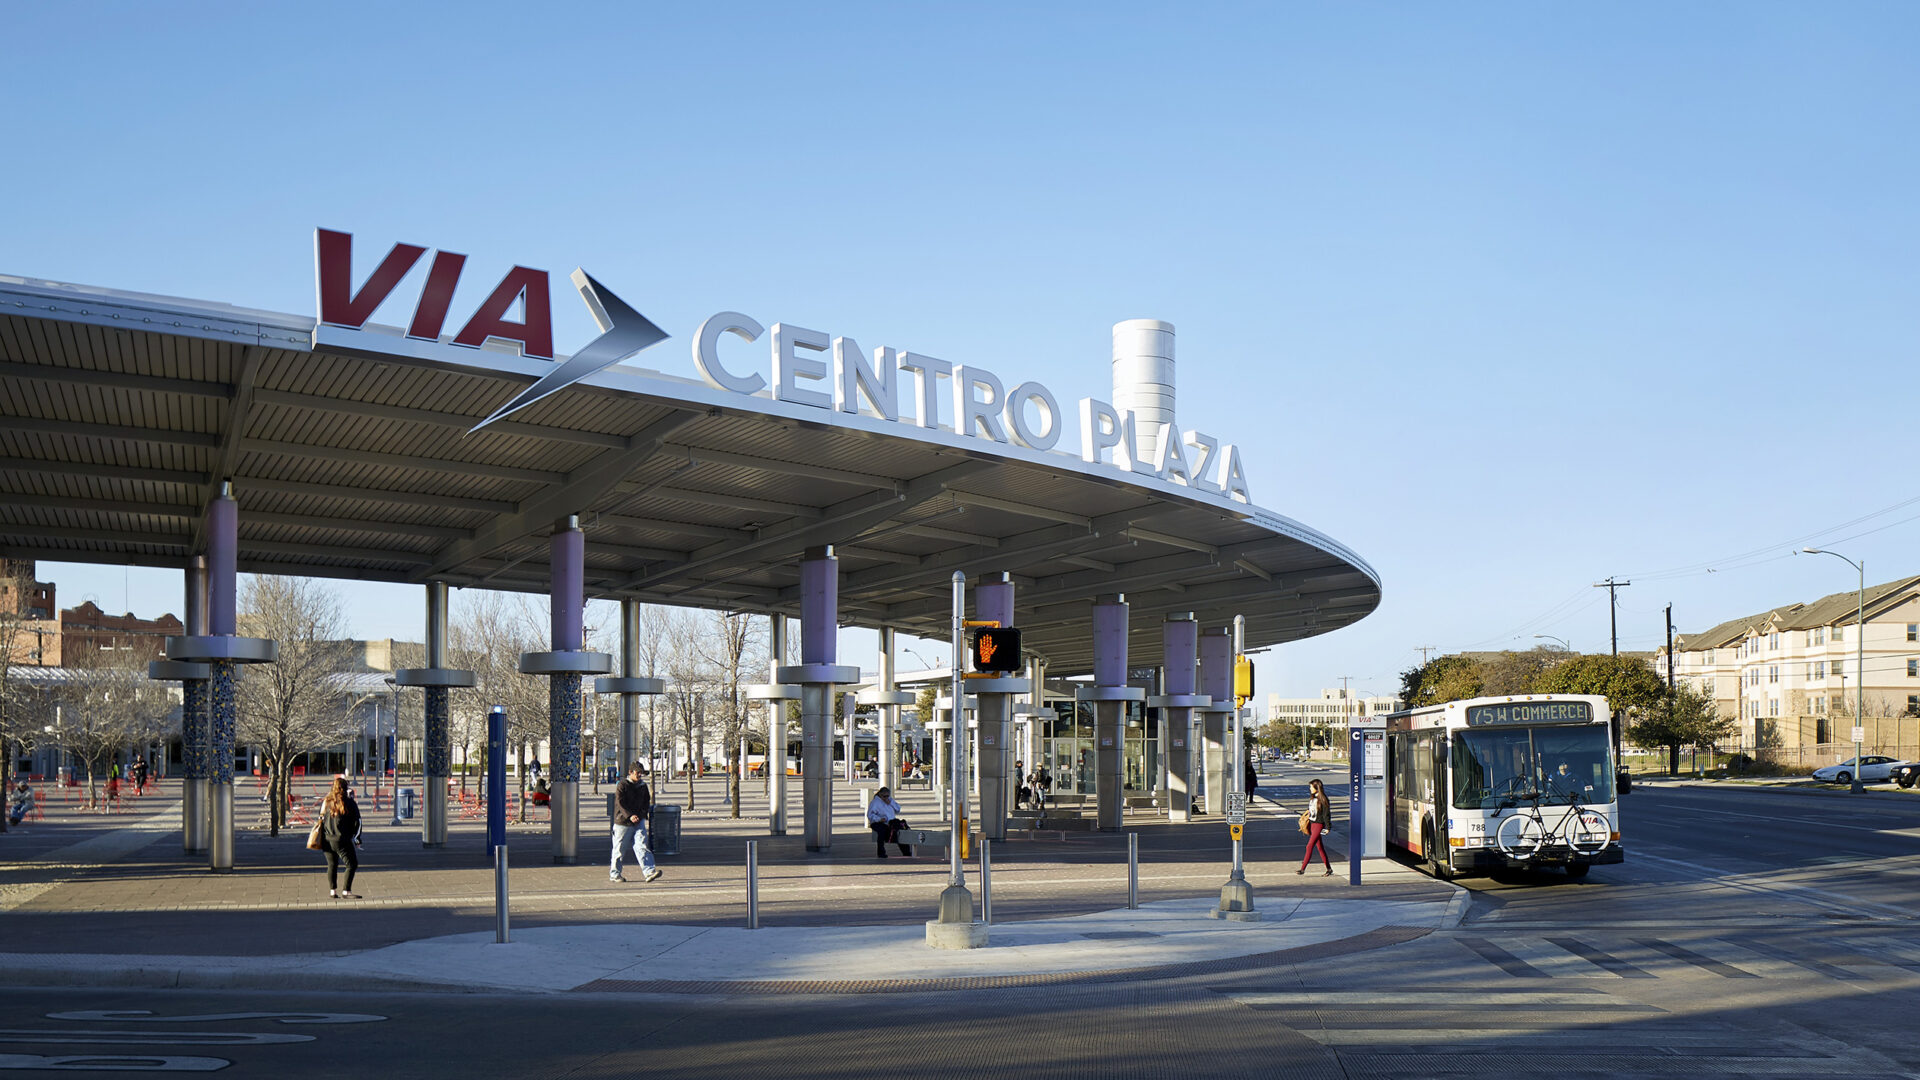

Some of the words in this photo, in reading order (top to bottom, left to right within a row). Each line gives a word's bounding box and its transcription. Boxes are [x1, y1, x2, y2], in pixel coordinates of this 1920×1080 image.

[313, 226, 554, 361] VIA
[691, 311, 1062, 451] CENTRO
[1079, 397, 1252, 504] PLAZA
[1497, 708, 1507, 722] W
[1512, 704, 1586, 721] COMMERCE
[1352, 731, 1360, 740] C
[1582, 816, 1598, 824] VIA
[1471, 823, 1486, 831] 788
